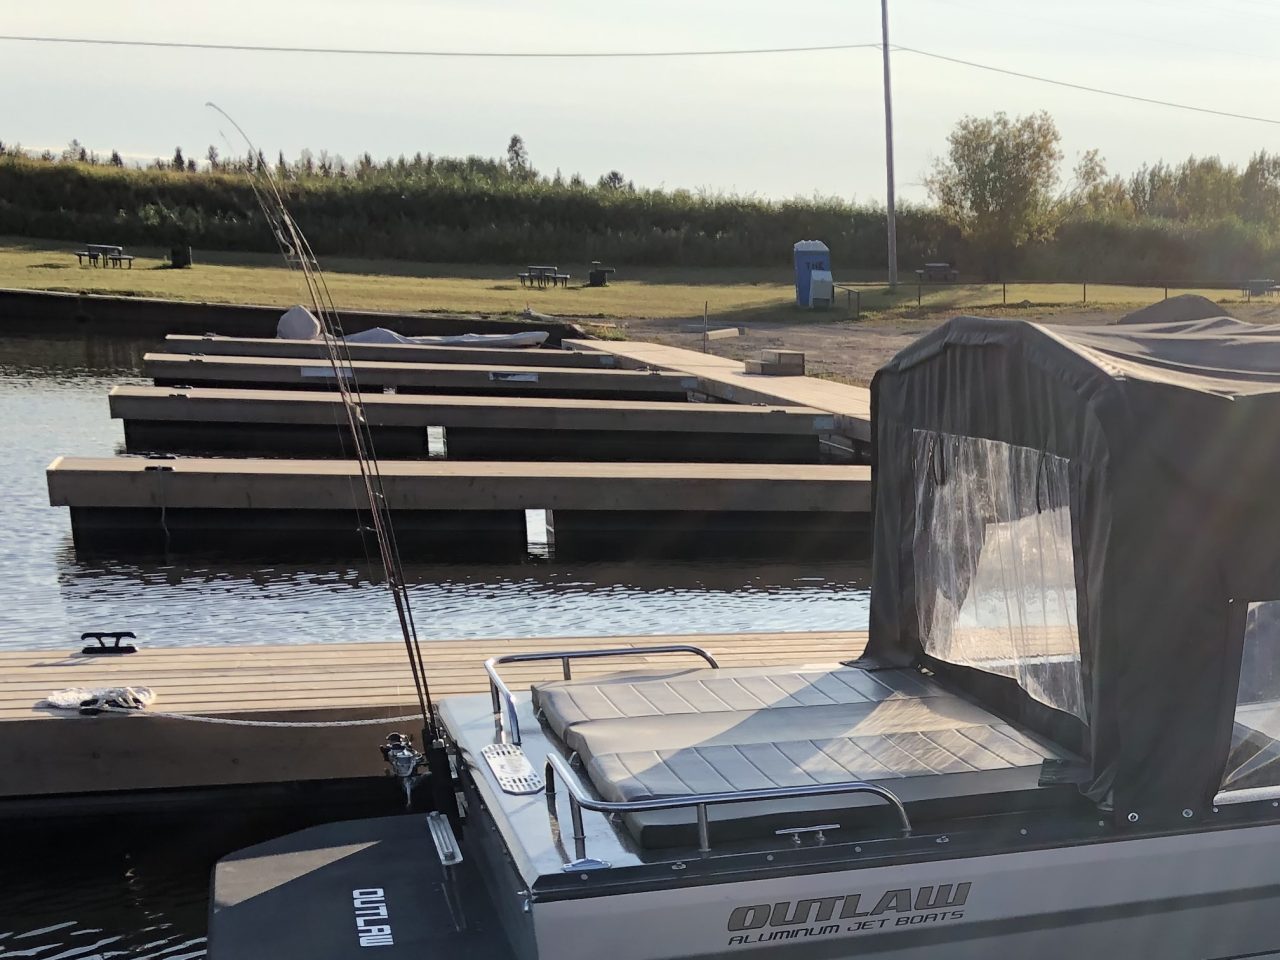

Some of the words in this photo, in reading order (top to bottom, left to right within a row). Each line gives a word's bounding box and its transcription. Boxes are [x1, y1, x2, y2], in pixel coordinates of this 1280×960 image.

[352, 888, 394, 946] OUTLAW
[727, 881, 972, 932] OUTLAW
[728, 924, 840, 945] ALUMINUM
[847, 918, 890, 932] JET
[895, 910, 965, 926] BOATS
